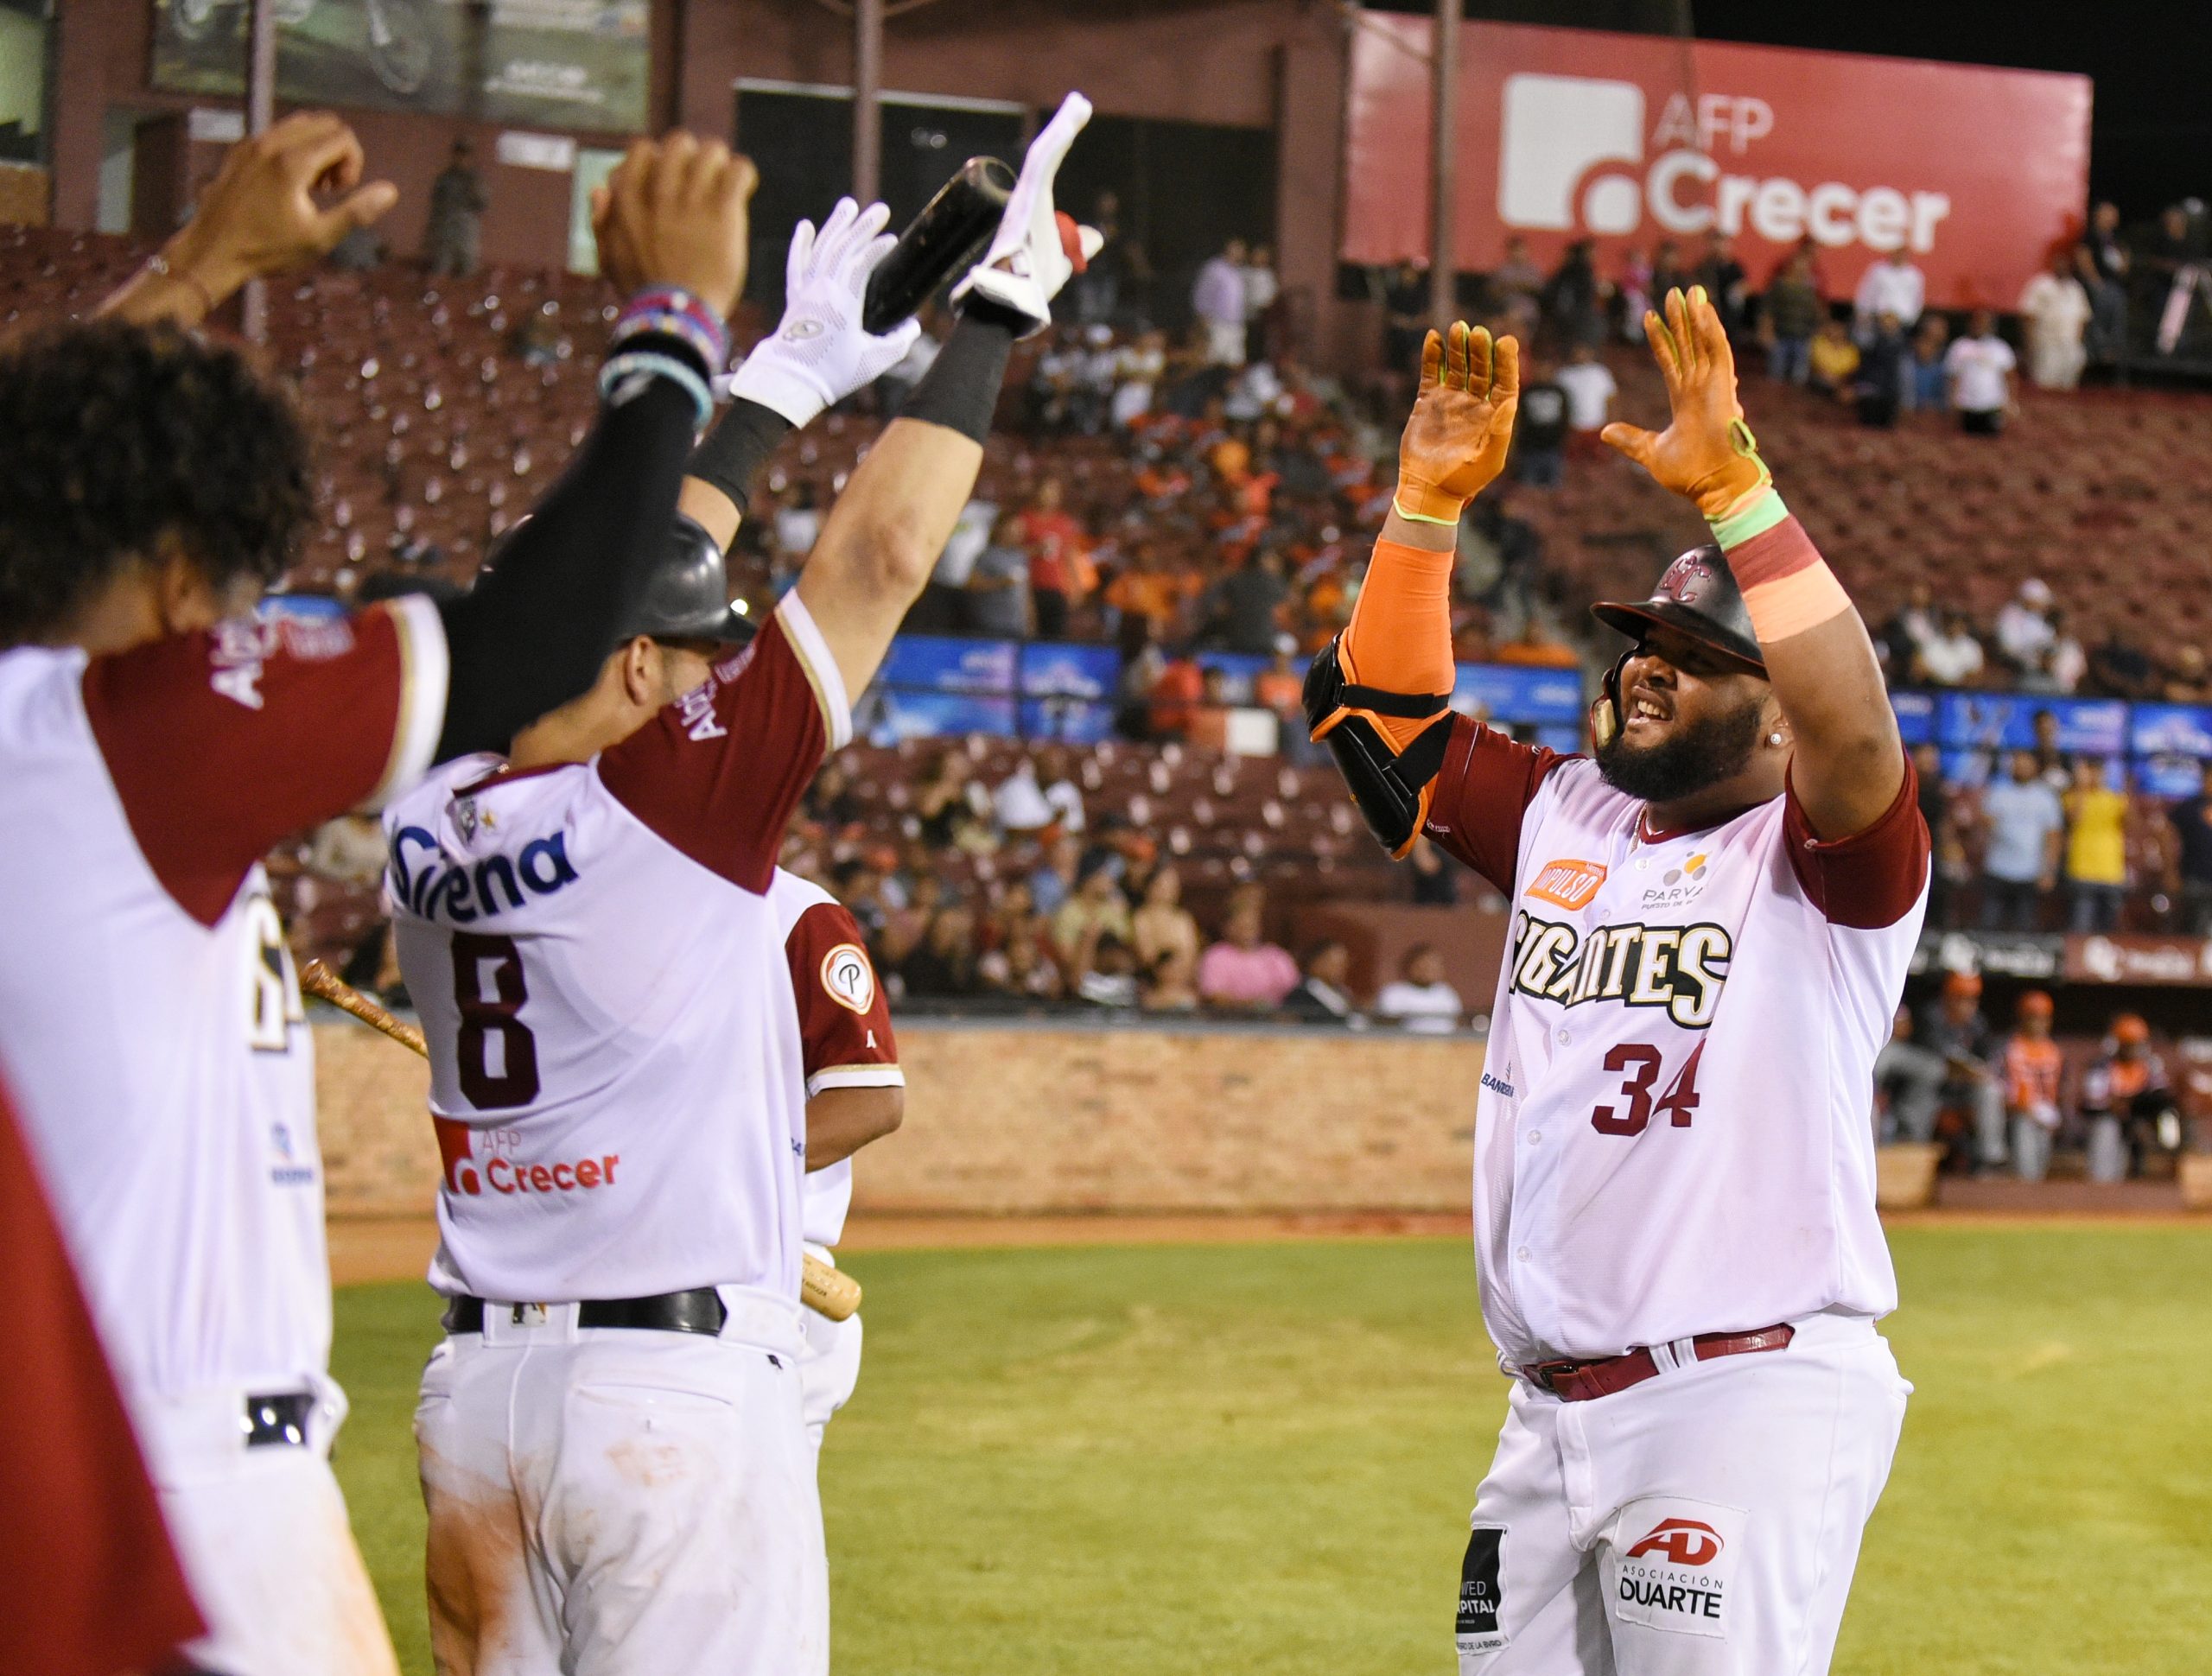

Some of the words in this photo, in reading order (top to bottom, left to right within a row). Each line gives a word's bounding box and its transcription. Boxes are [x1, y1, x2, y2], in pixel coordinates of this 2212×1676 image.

[1653, 92, 1775, 156] AFP
[1646, 149, 1951, 253] Crecer
[451, 931, 542, 1111] 8
[1591, 1038, 1706, 1137] 34
[482, 1128, 522, 1155] AFP
[486, 1154, 620, 1194] Crecer
[1620, 1577, 1722, 1619] DUARTE
[1623, 1565, 1724, 1590] ASOCIACIÓN
